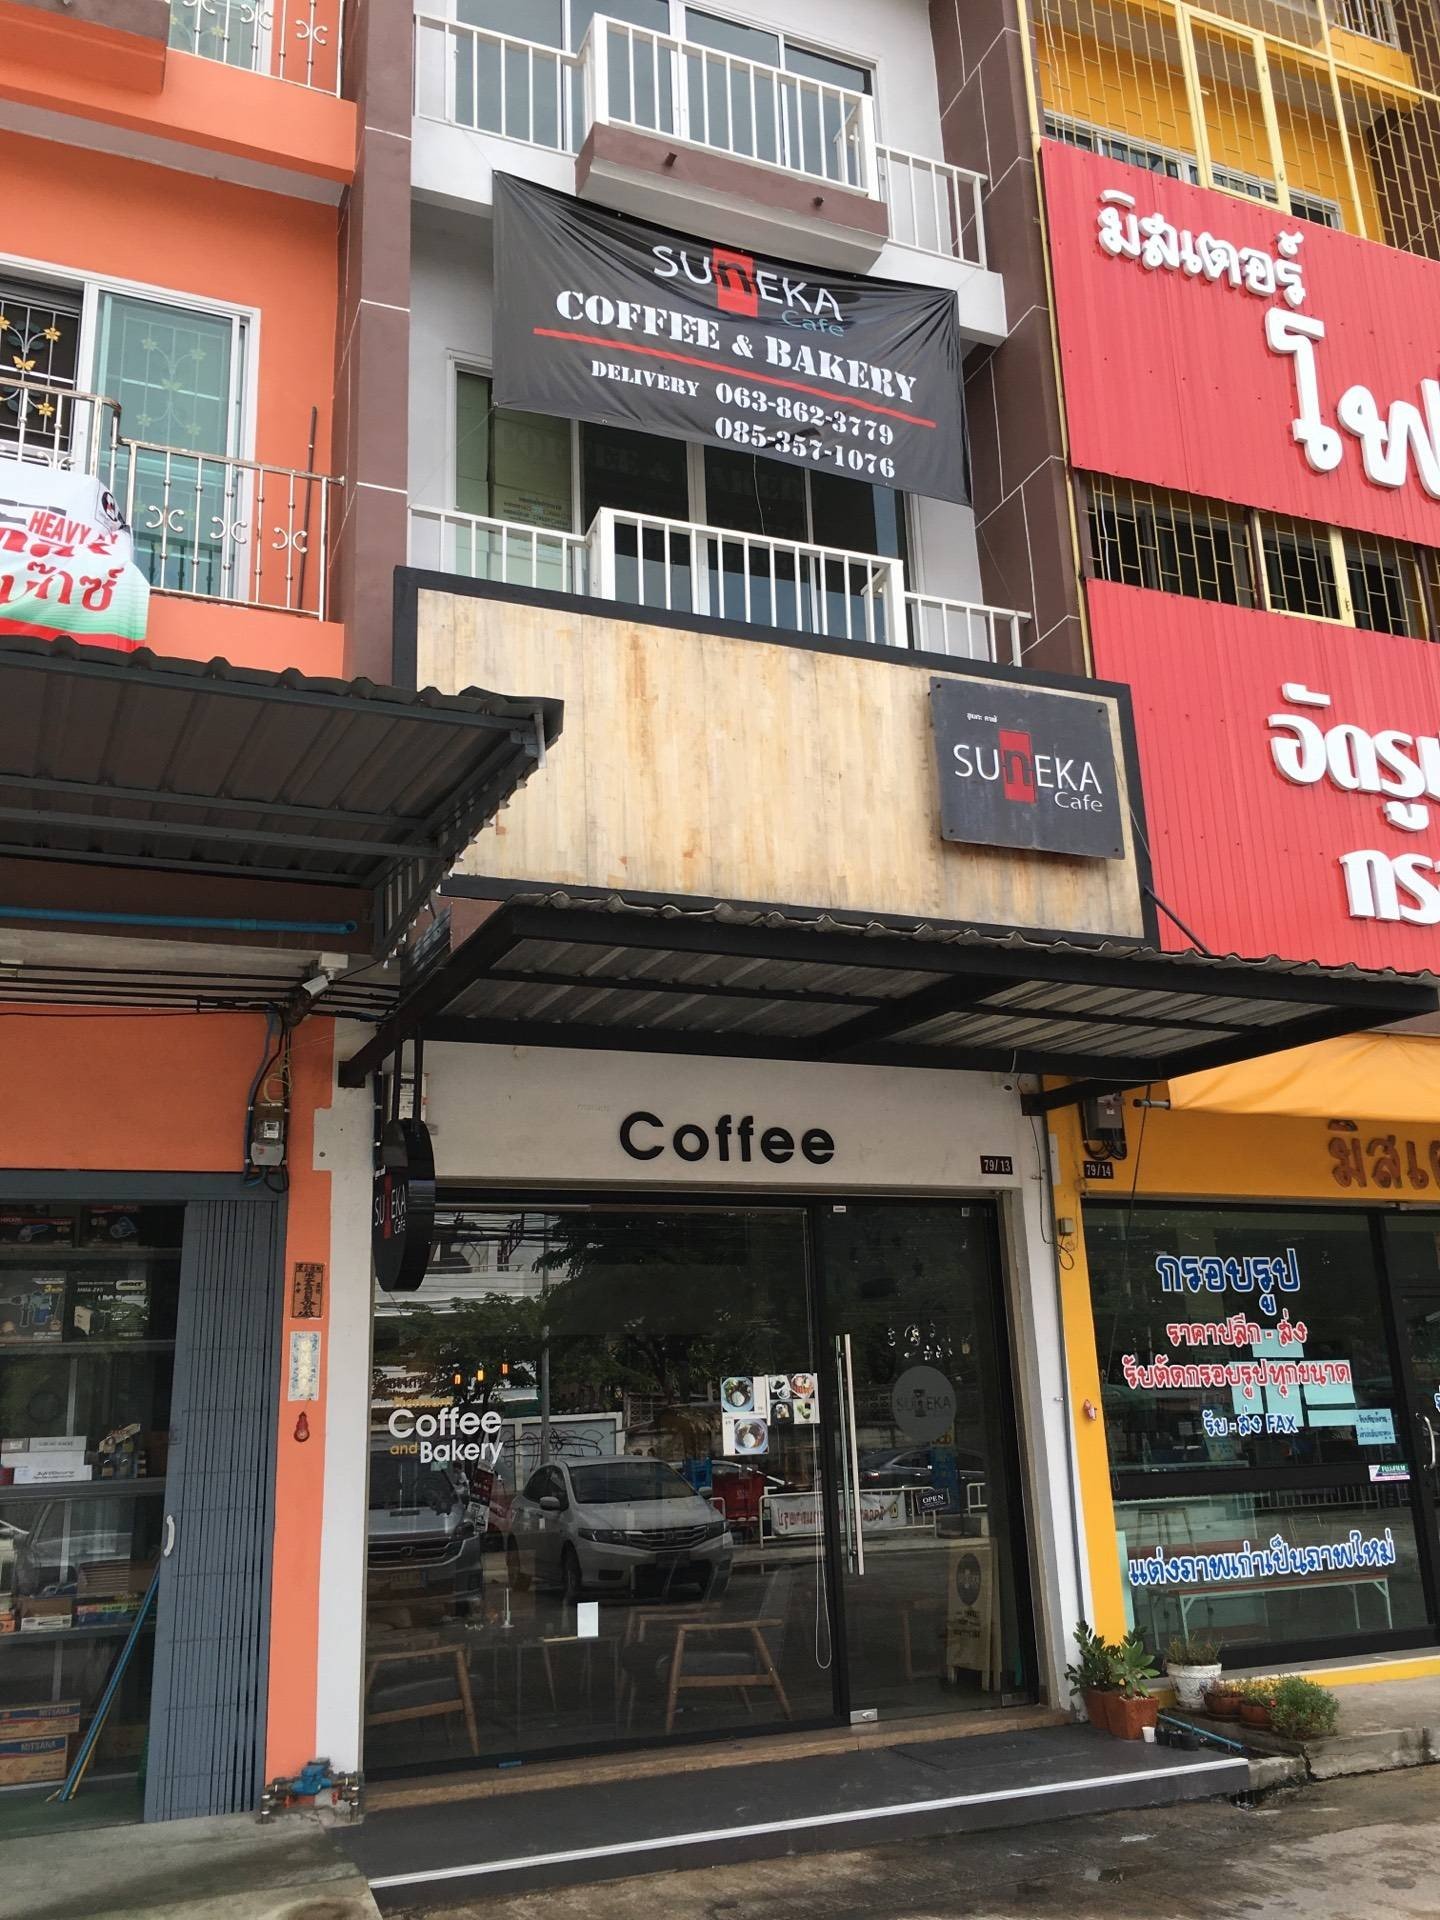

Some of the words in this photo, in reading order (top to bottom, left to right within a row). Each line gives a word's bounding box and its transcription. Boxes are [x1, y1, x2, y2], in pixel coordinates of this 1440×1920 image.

[1097, 189, 1306, 308] มิสเตอร์
[780, 309, 844, 337] Cafe
[556, 290, 720, 350] COFFEE
[731, 334, 753, 359] &
[765, 335, 917, 403] BAKERY
[591, 360, 700, 398] DELIVERY
[715, 382, 894, 446] 063-862-3779
[715, 417, 895, 479] 085-357-1076
[28, 510, 92, 545] HEAVY
[1054, 791, 1103, 812] Cafe
[1339, 849, 1440, 926] กร
[619, 1111, 835, 1165] Coffee
[983, 1158, 1012, 1173] 79/13
[1085, 1163, 1112, 1178] 79/14
[1155, 1247, 1301, 1316] กรอบรูป
[1166, 1312, 1261, 1347] ราคาปลีก
[1276, 1307, 1308, 1347] ส่ง
[1122, 1353, 1353, 1399] รับตัดกรอบรูปทุกขนาด
[388, 1406, 502, 1439] Coffee
[1265, 1413, 1300, 1436] FAX
[390, 1442, 418, 1455] and
[420, 1439, 504, 1467] Bakery
[922, 1493, 944, 1505] OPEN
[1128, 1528, 1395, 1585] แต่งภาพเก่าเป็นภาพใหม่
